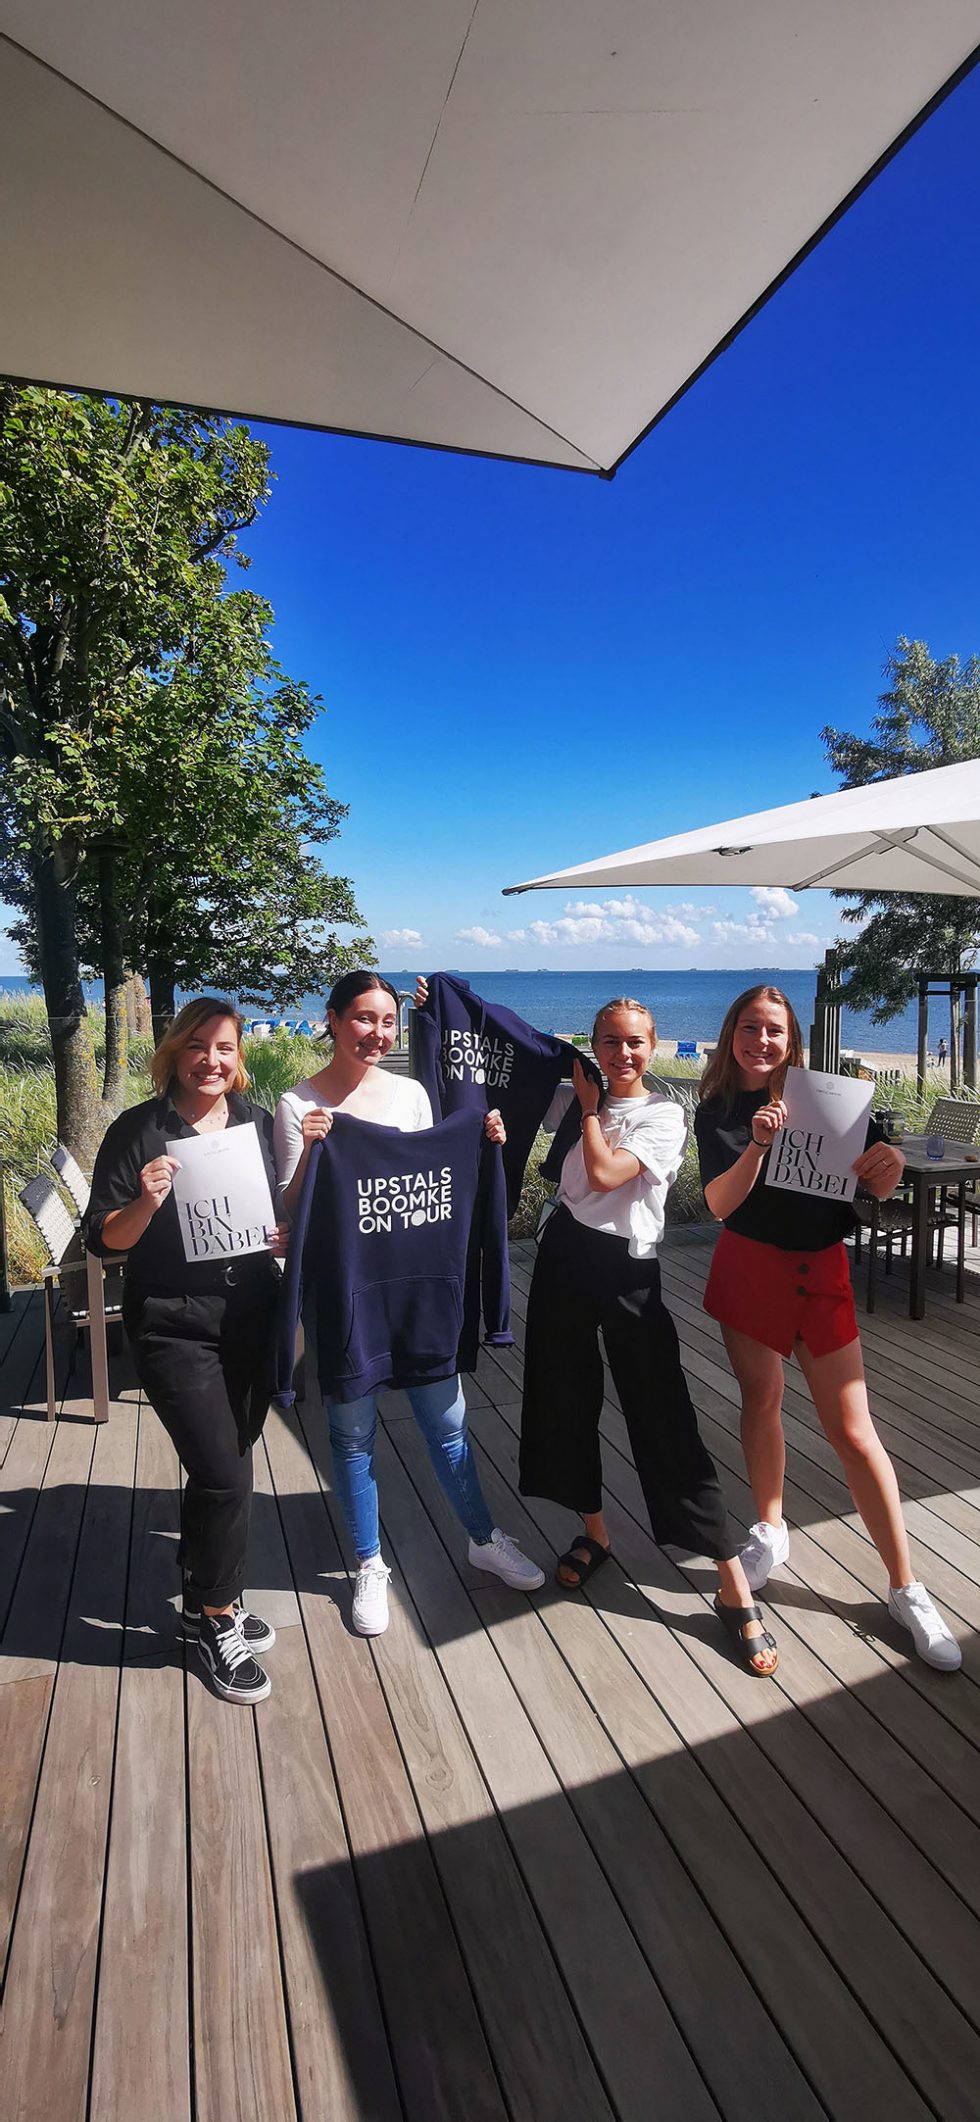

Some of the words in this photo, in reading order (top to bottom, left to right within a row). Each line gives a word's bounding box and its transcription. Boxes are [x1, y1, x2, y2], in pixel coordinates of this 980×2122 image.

[470, 1066, 510, 1089] TOUR
[781, 1127, 824, 1153] ICH
[777, 1146, 821, 1171] BIN
[357, 1166, 452, 1197] UPSTALS
[773, 1164, 849, 1196] DABEI
[186, 1196, 231, 1220] ICH
[358, 1184, 452, 1216] BOOMKE
[188, 1215, 233, 1238] BIN
[358, 1215, 392, 1234] ON
[400, 1203, 452, 1229] TOUR
[192, 1225, 270, 1256] DABEI
